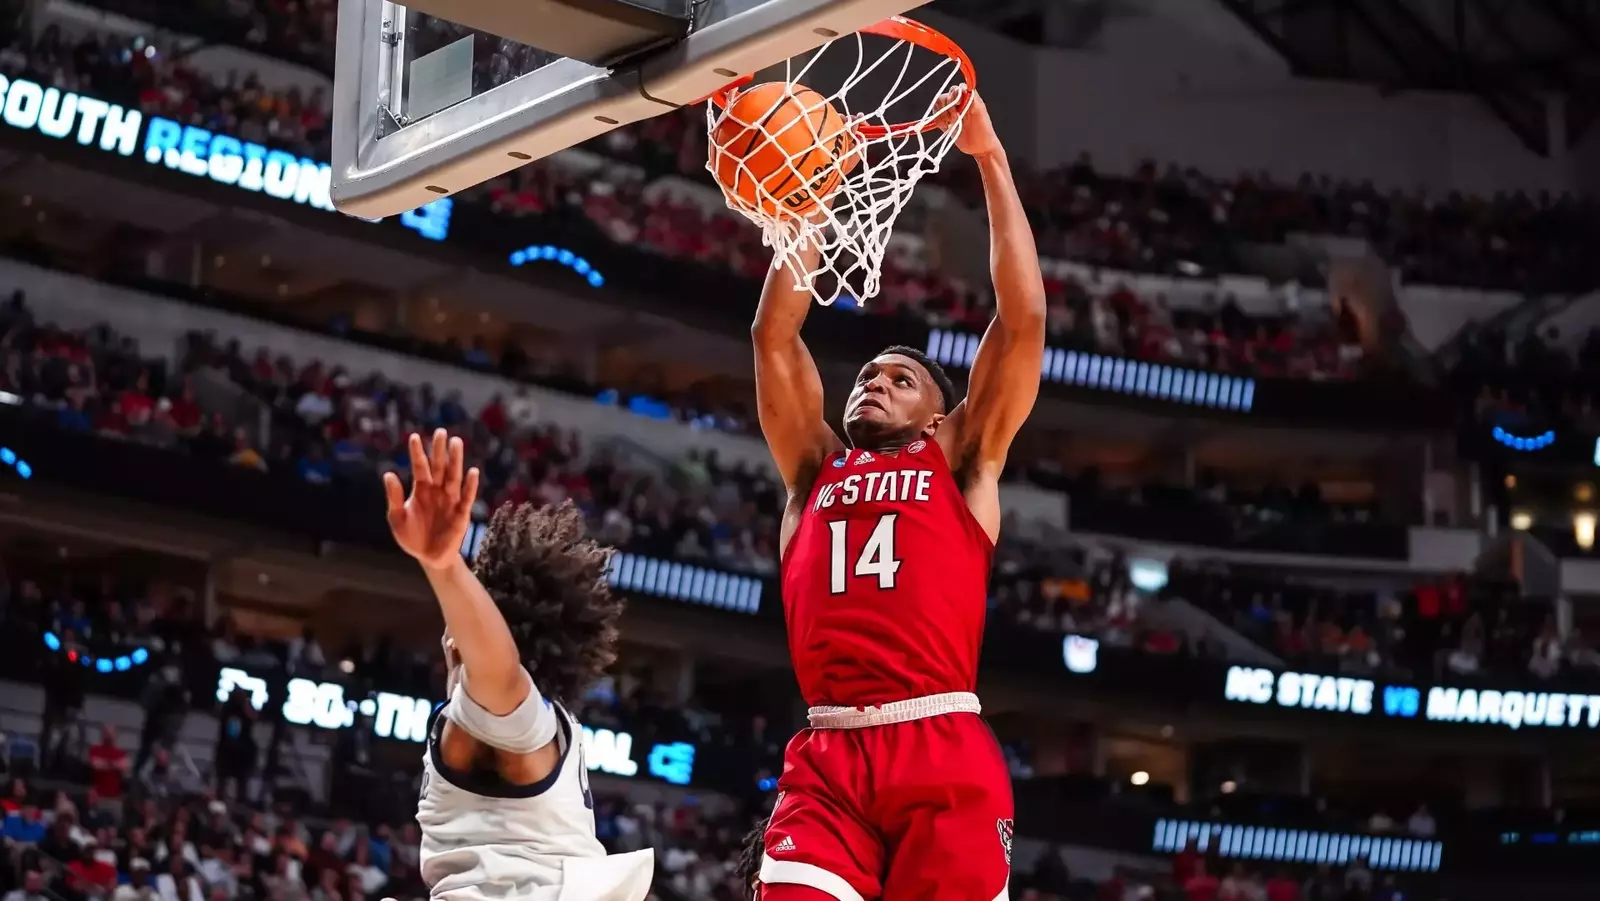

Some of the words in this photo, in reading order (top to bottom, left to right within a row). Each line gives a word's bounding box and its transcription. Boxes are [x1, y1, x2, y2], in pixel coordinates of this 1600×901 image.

[841, 469, 934, 505] STATE
[827, 512, 902, 595] 14
[1225, 666, 1274, 703] NC
[1277, 672, 1374, 714] STATE
[1383, 686, 1420, 716] VS
